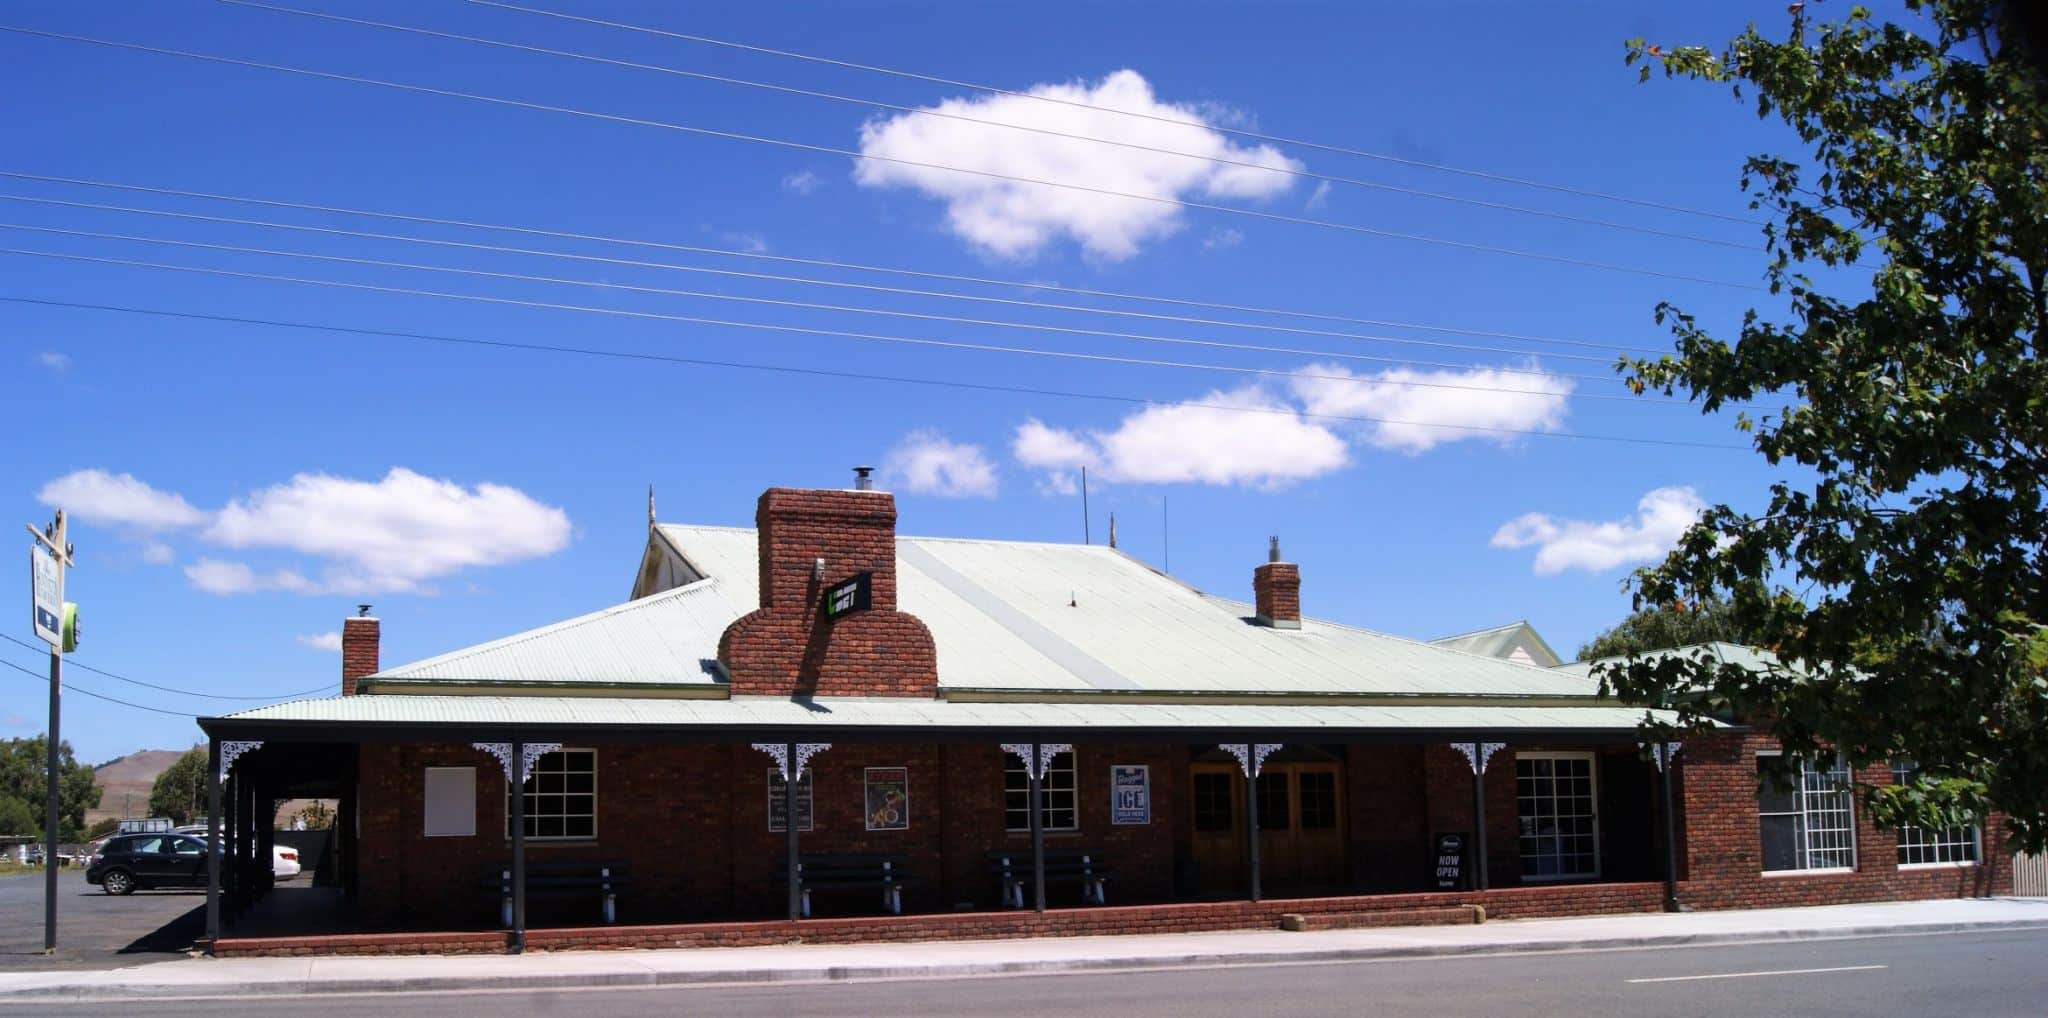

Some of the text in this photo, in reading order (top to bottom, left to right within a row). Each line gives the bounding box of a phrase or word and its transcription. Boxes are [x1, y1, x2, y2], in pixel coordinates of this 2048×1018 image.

[1118, 790, 1144, 809] ICE
[1439, 855, 1459, 865] NOW
[1436, 866, 1459, 878] OPEN
